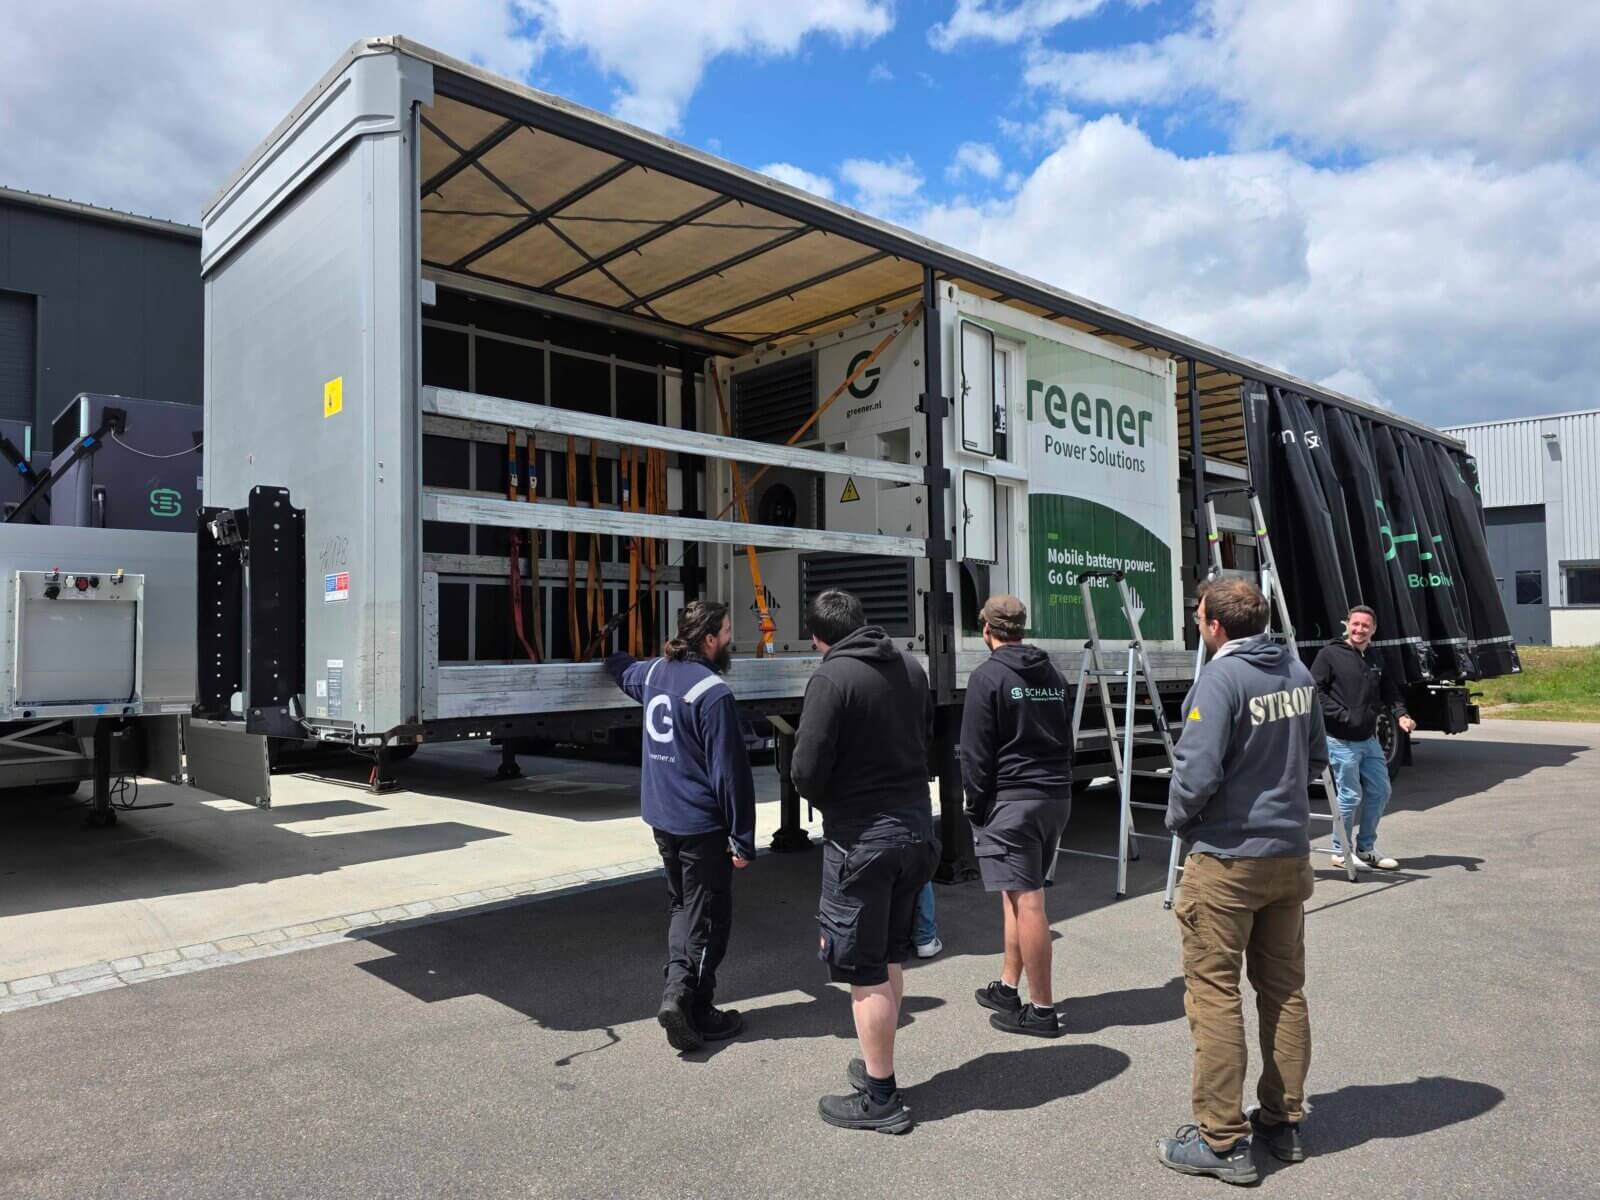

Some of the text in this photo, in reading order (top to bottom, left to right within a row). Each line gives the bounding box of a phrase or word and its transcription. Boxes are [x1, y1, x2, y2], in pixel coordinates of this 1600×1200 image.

[846, 400, 882, 419] greener.nl
[1045, 434, 1146, 473] Power Solutions
[1047, 548, 1156, 573] Mobile battery power.
[1048, 569, 1110, 589] Go Grener.
[646, 694, 673, 743] G
